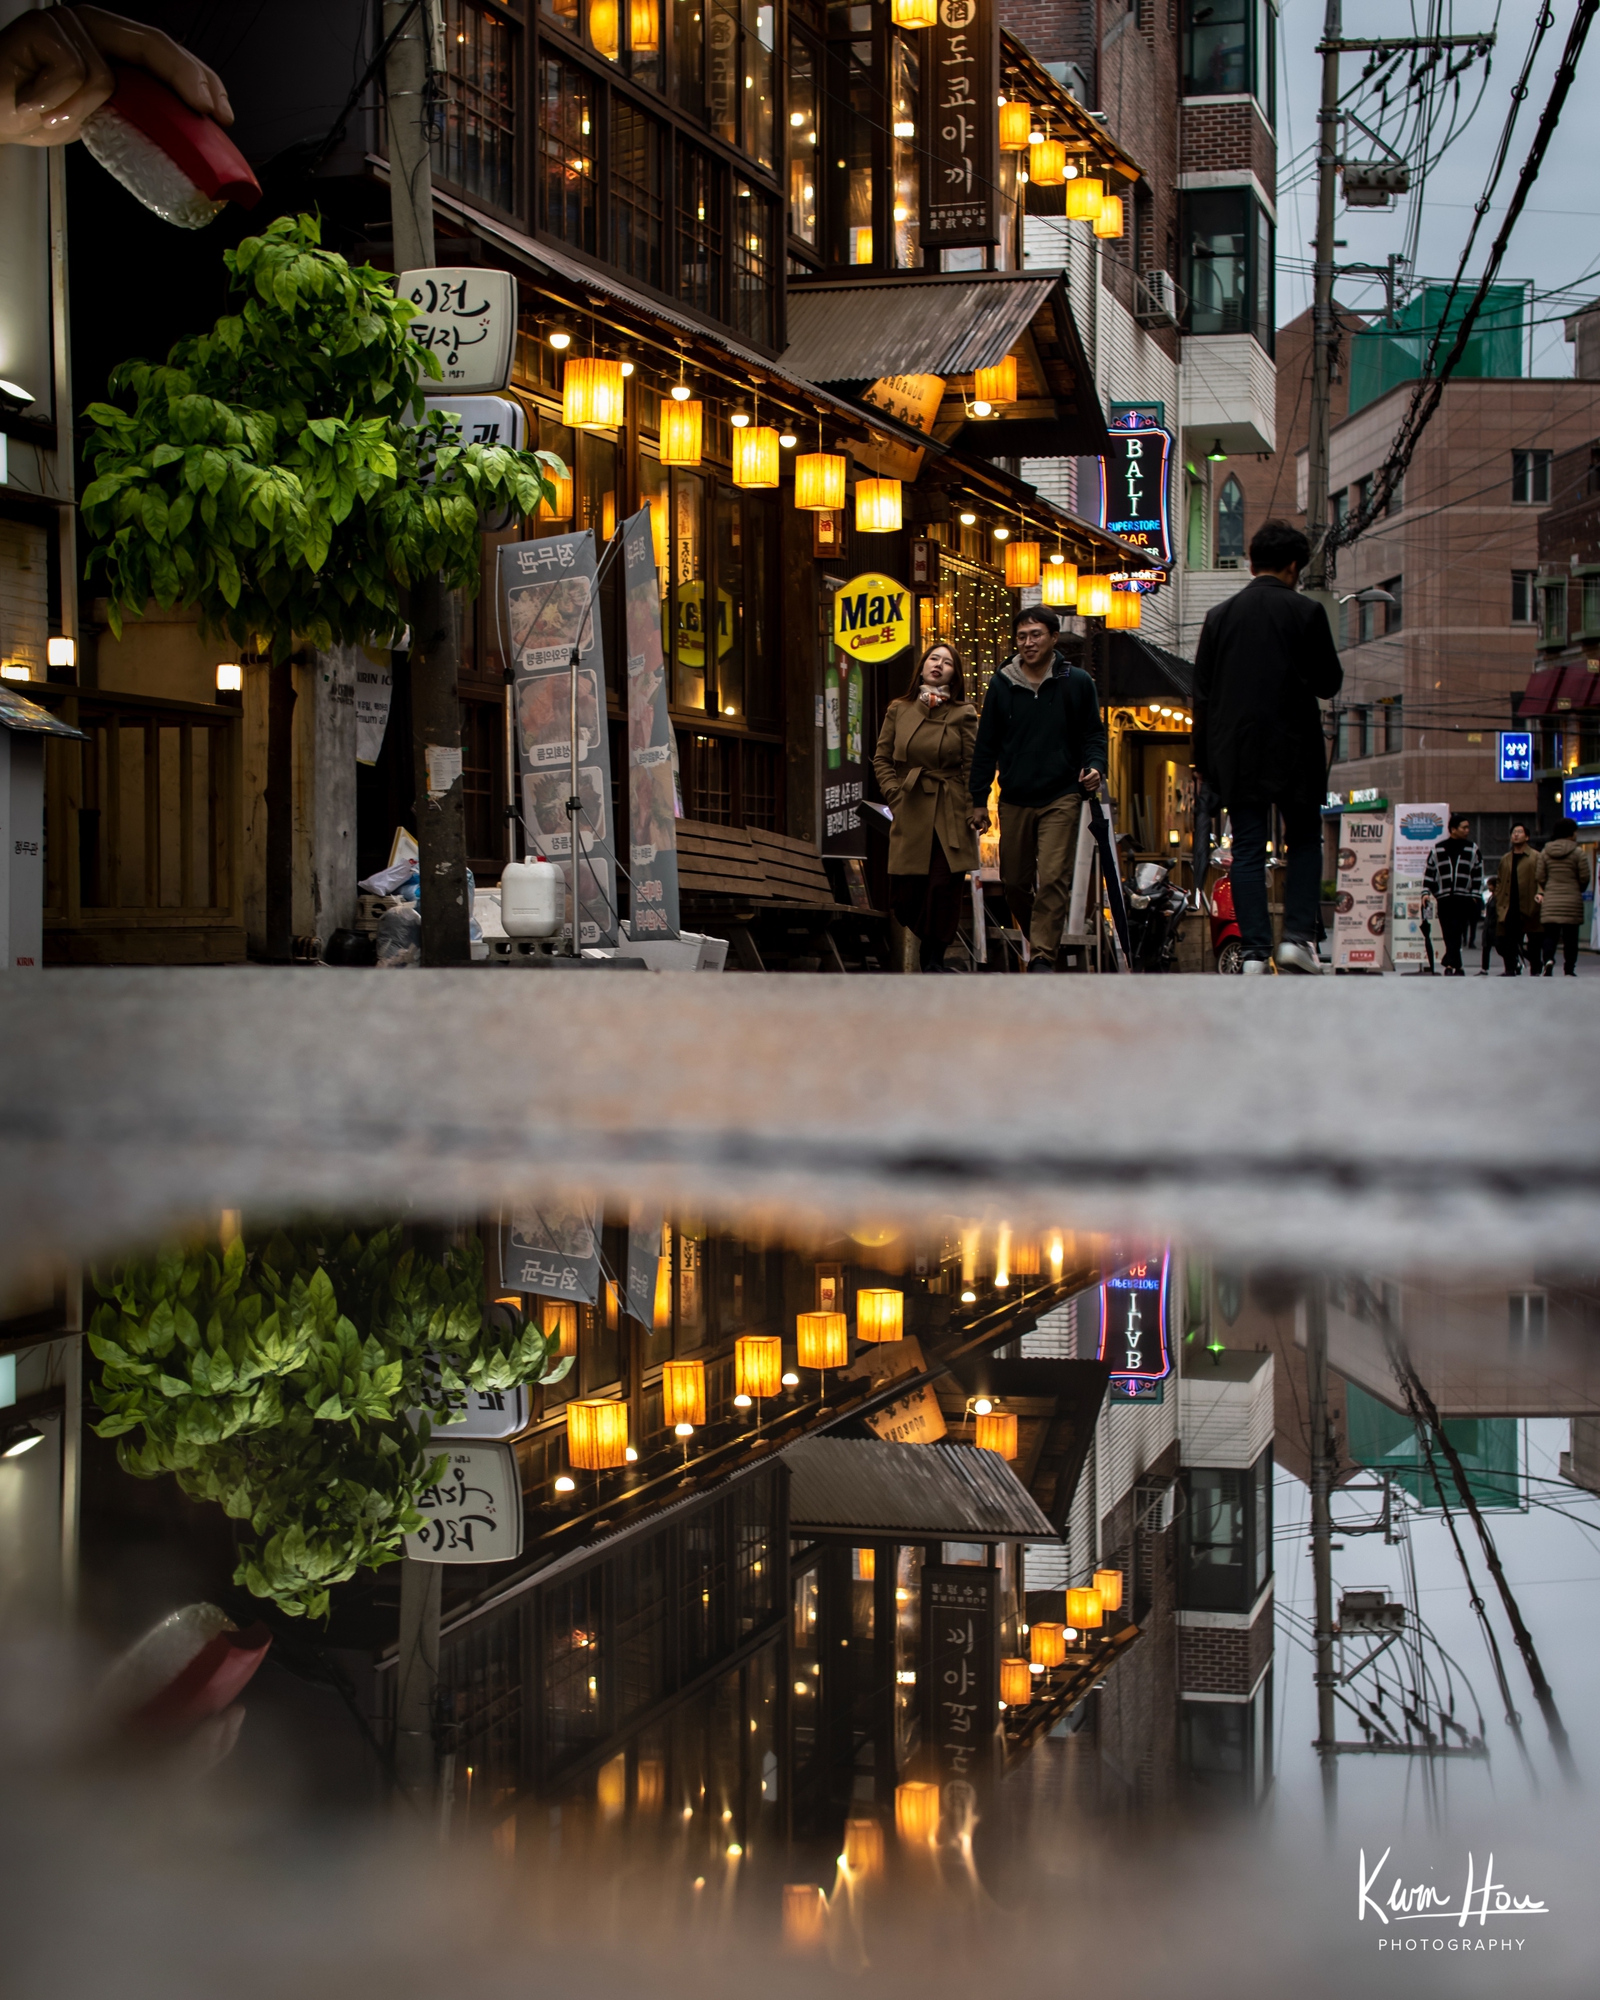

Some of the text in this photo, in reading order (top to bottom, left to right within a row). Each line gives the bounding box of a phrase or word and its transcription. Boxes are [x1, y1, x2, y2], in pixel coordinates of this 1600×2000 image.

[940, 34, 976, 195] 도쿄야끼
[1124, 438, 1144, 517] BALI
[1107, 519, 1161, 532] SUPERSTORE
[840, 592, 905, 633] Max
[1505, 742, 1528, 757] 상상
[1350, 824, 1384, 838] MENU
[16, 956, 35, 967] KIRIN
